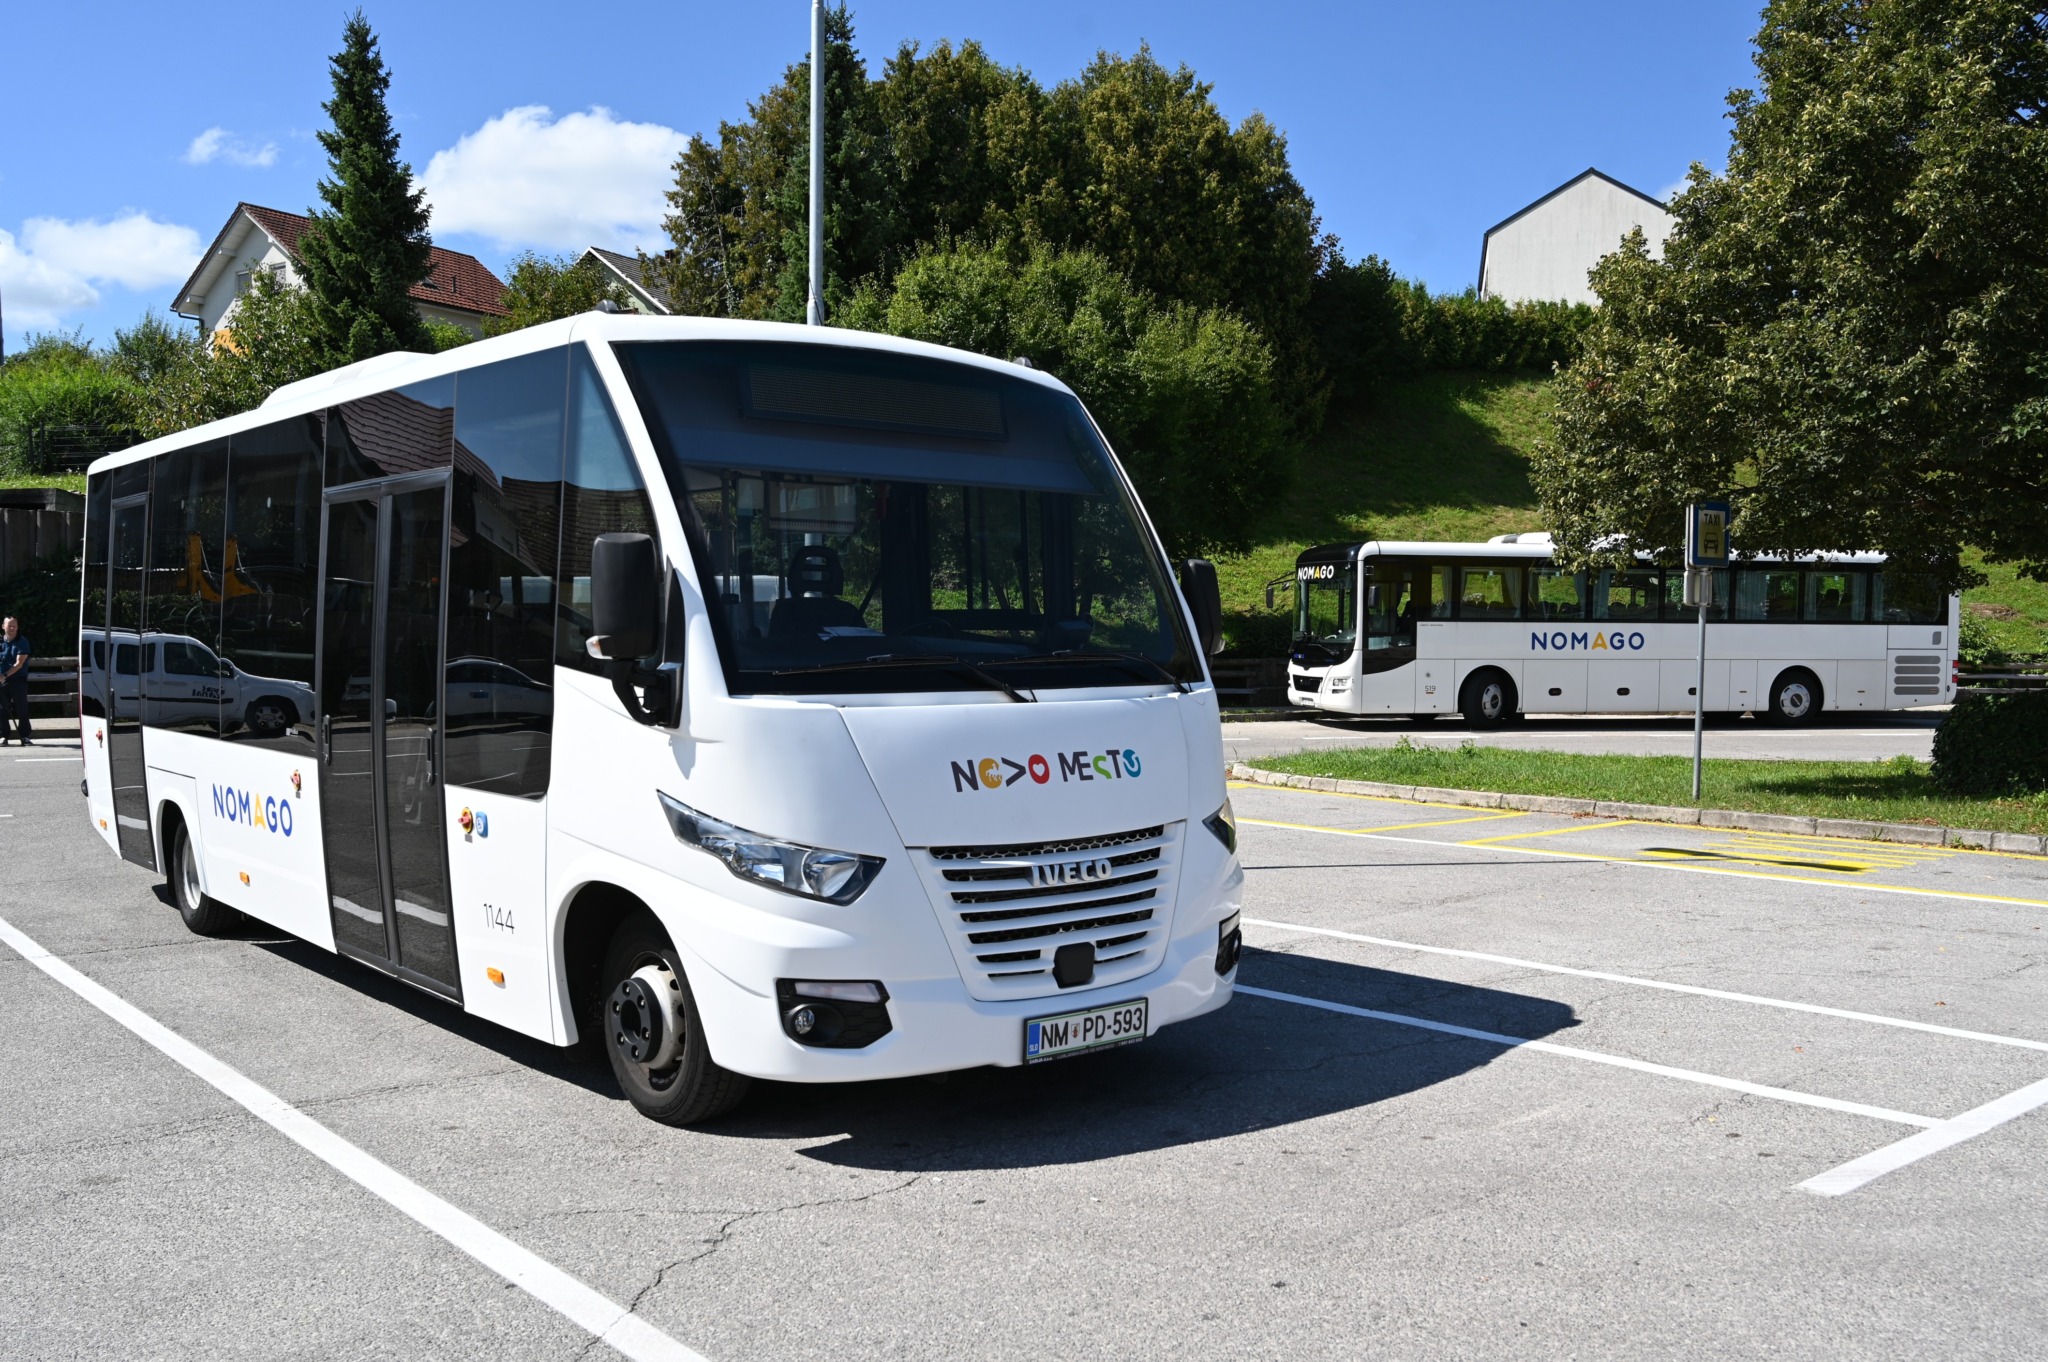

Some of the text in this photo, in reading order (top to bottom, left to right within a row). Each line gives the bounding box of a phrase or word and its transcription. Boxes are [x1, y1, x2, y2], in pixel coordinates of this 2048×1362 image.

[1704, 513, 1721, 526] TAXI
[1297, 565, 1335, 581] NOMAGO
[1531, 631, 1645, 651] NOMAGO
[1057, 748, 1142, 783] MESTO
[212, 782, 293, 837] NOMAGO
[1031, 858, 1113, 887] IVECO
[483, 902, 515, 935] 1144
[1041, 1007, 1143, 1050] NM PD-593
[1029, 1043, 1039, 1052] SLO
